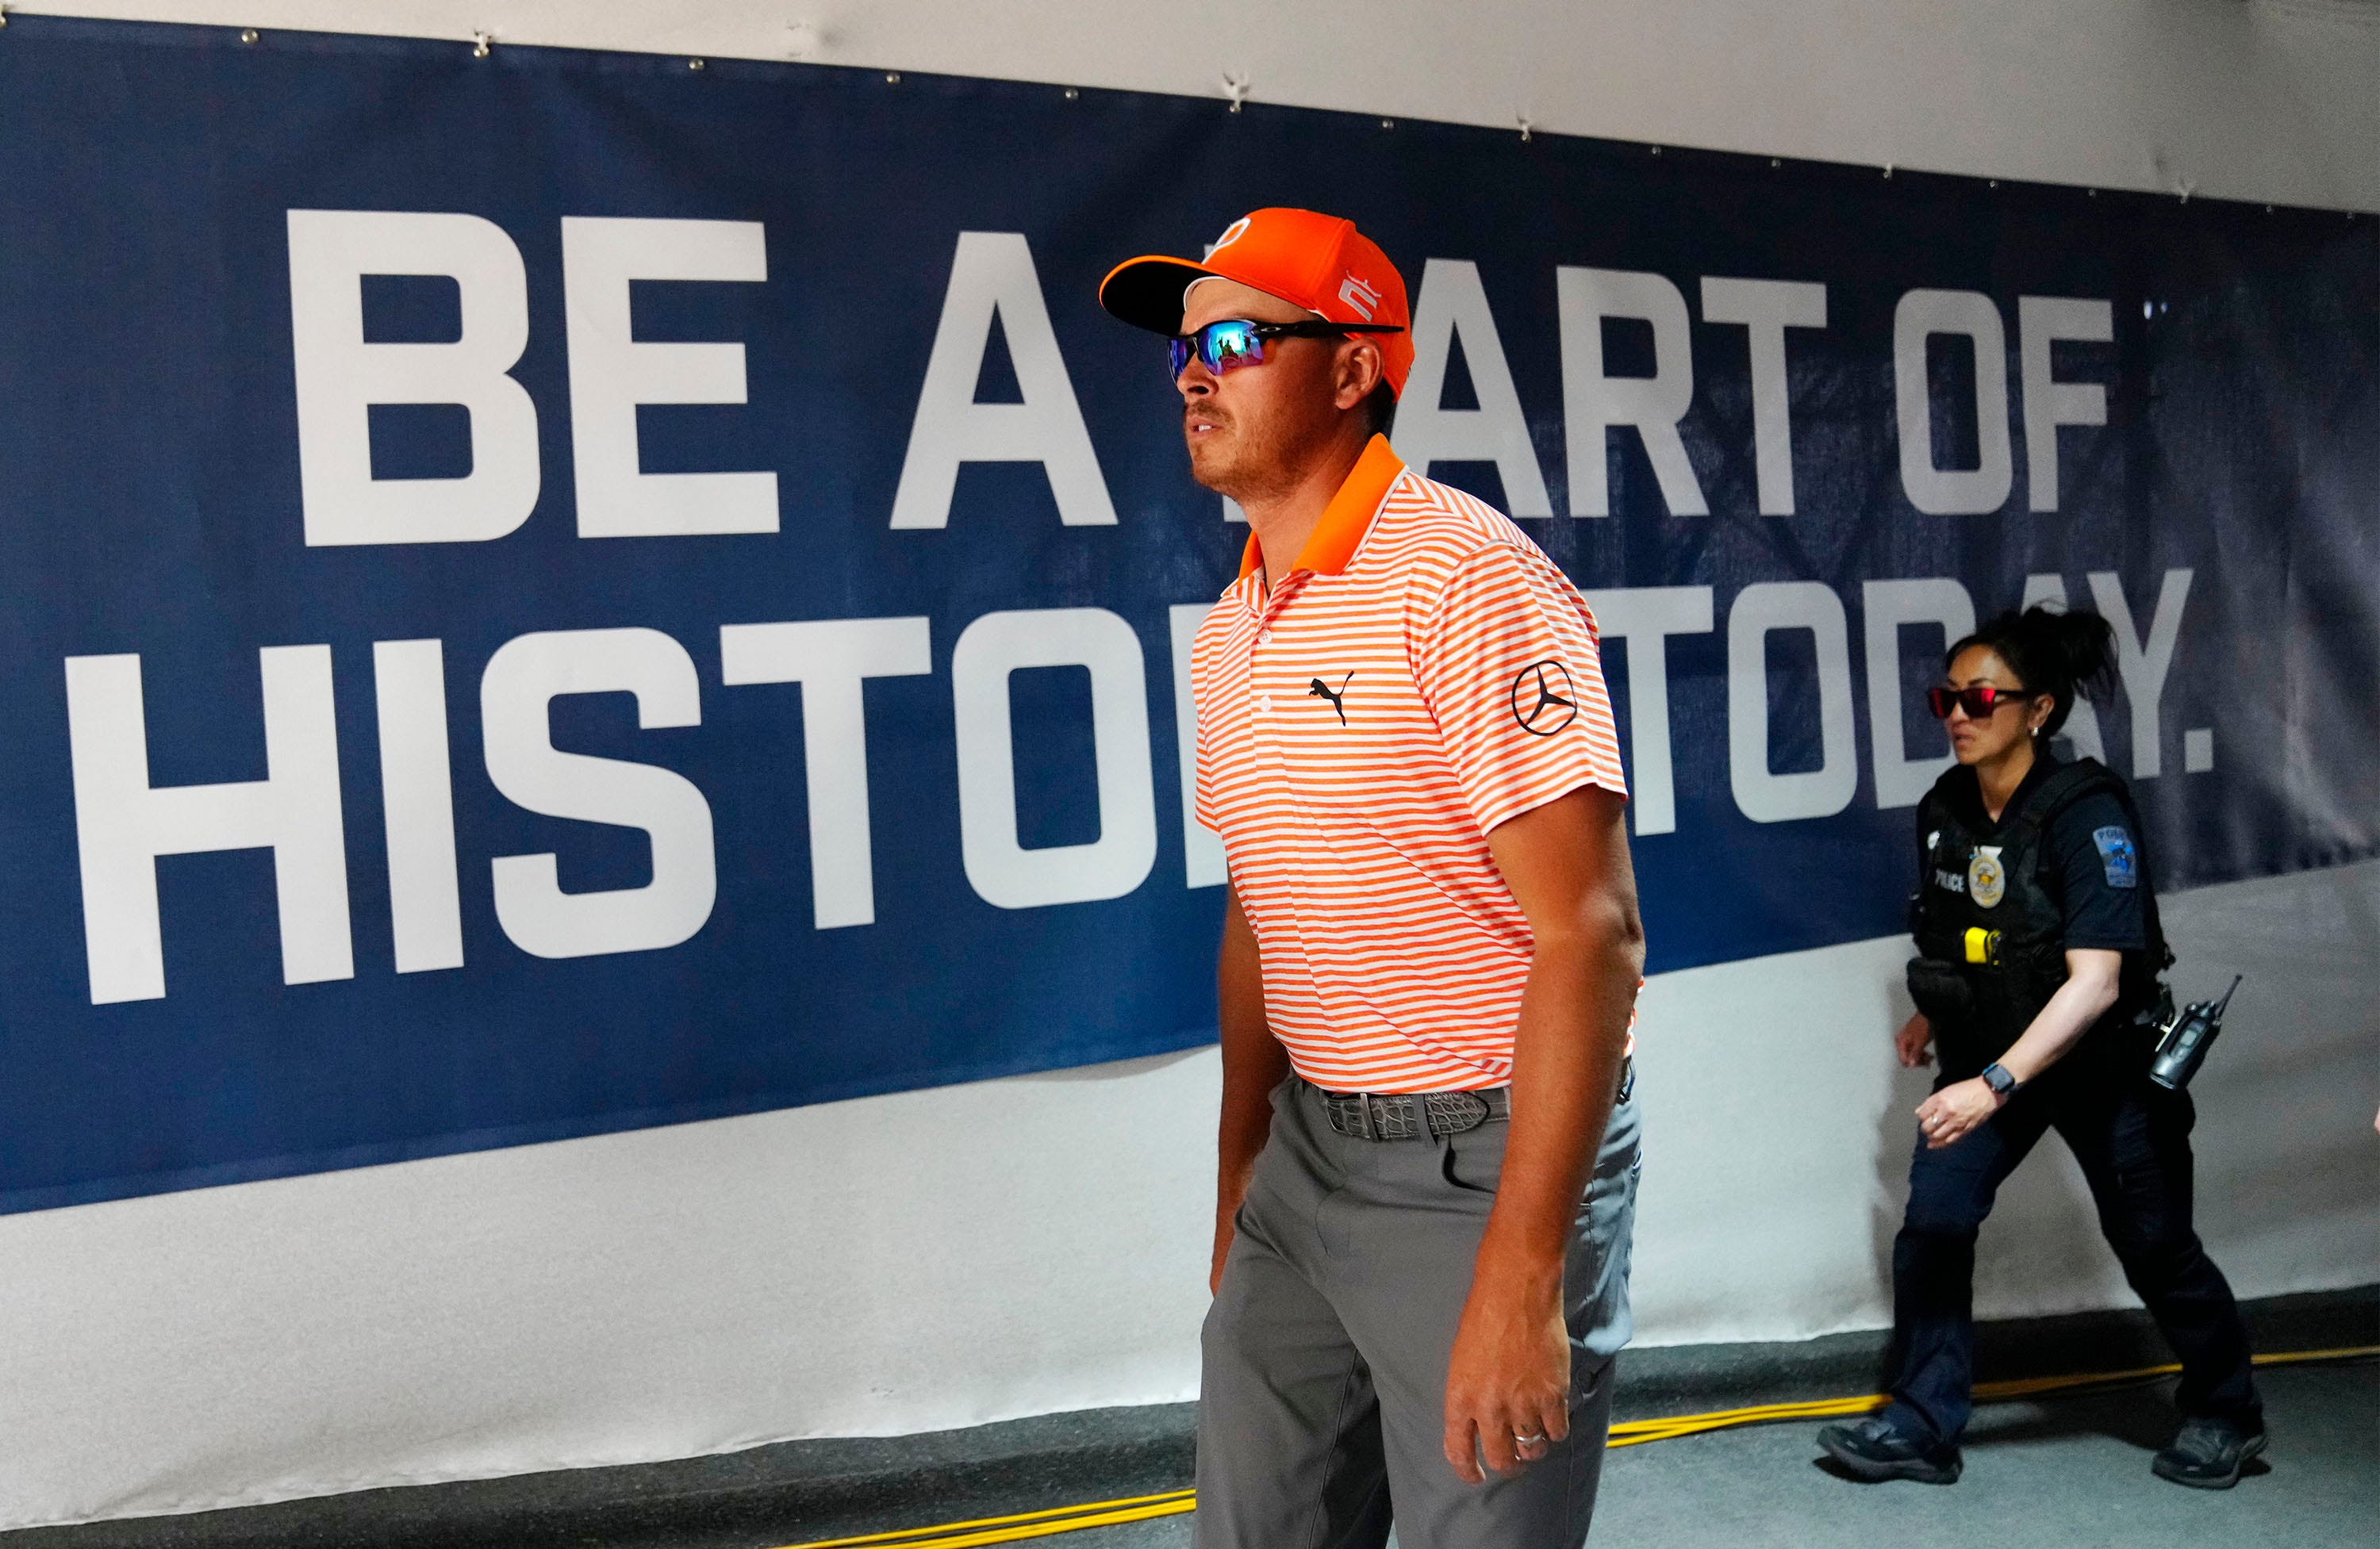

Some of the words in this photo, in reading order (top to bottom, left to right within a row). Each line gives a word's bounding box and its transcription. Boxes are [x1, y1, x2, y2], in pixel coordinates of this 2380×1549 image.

[286, 209, 780, 546] BE
[889, 231, 1119, 530] A
[1204, 243, 1827, 522] ART
[1894, 288, 2113, 516] OF
[65, 627, 1231, 1005] HISTO
